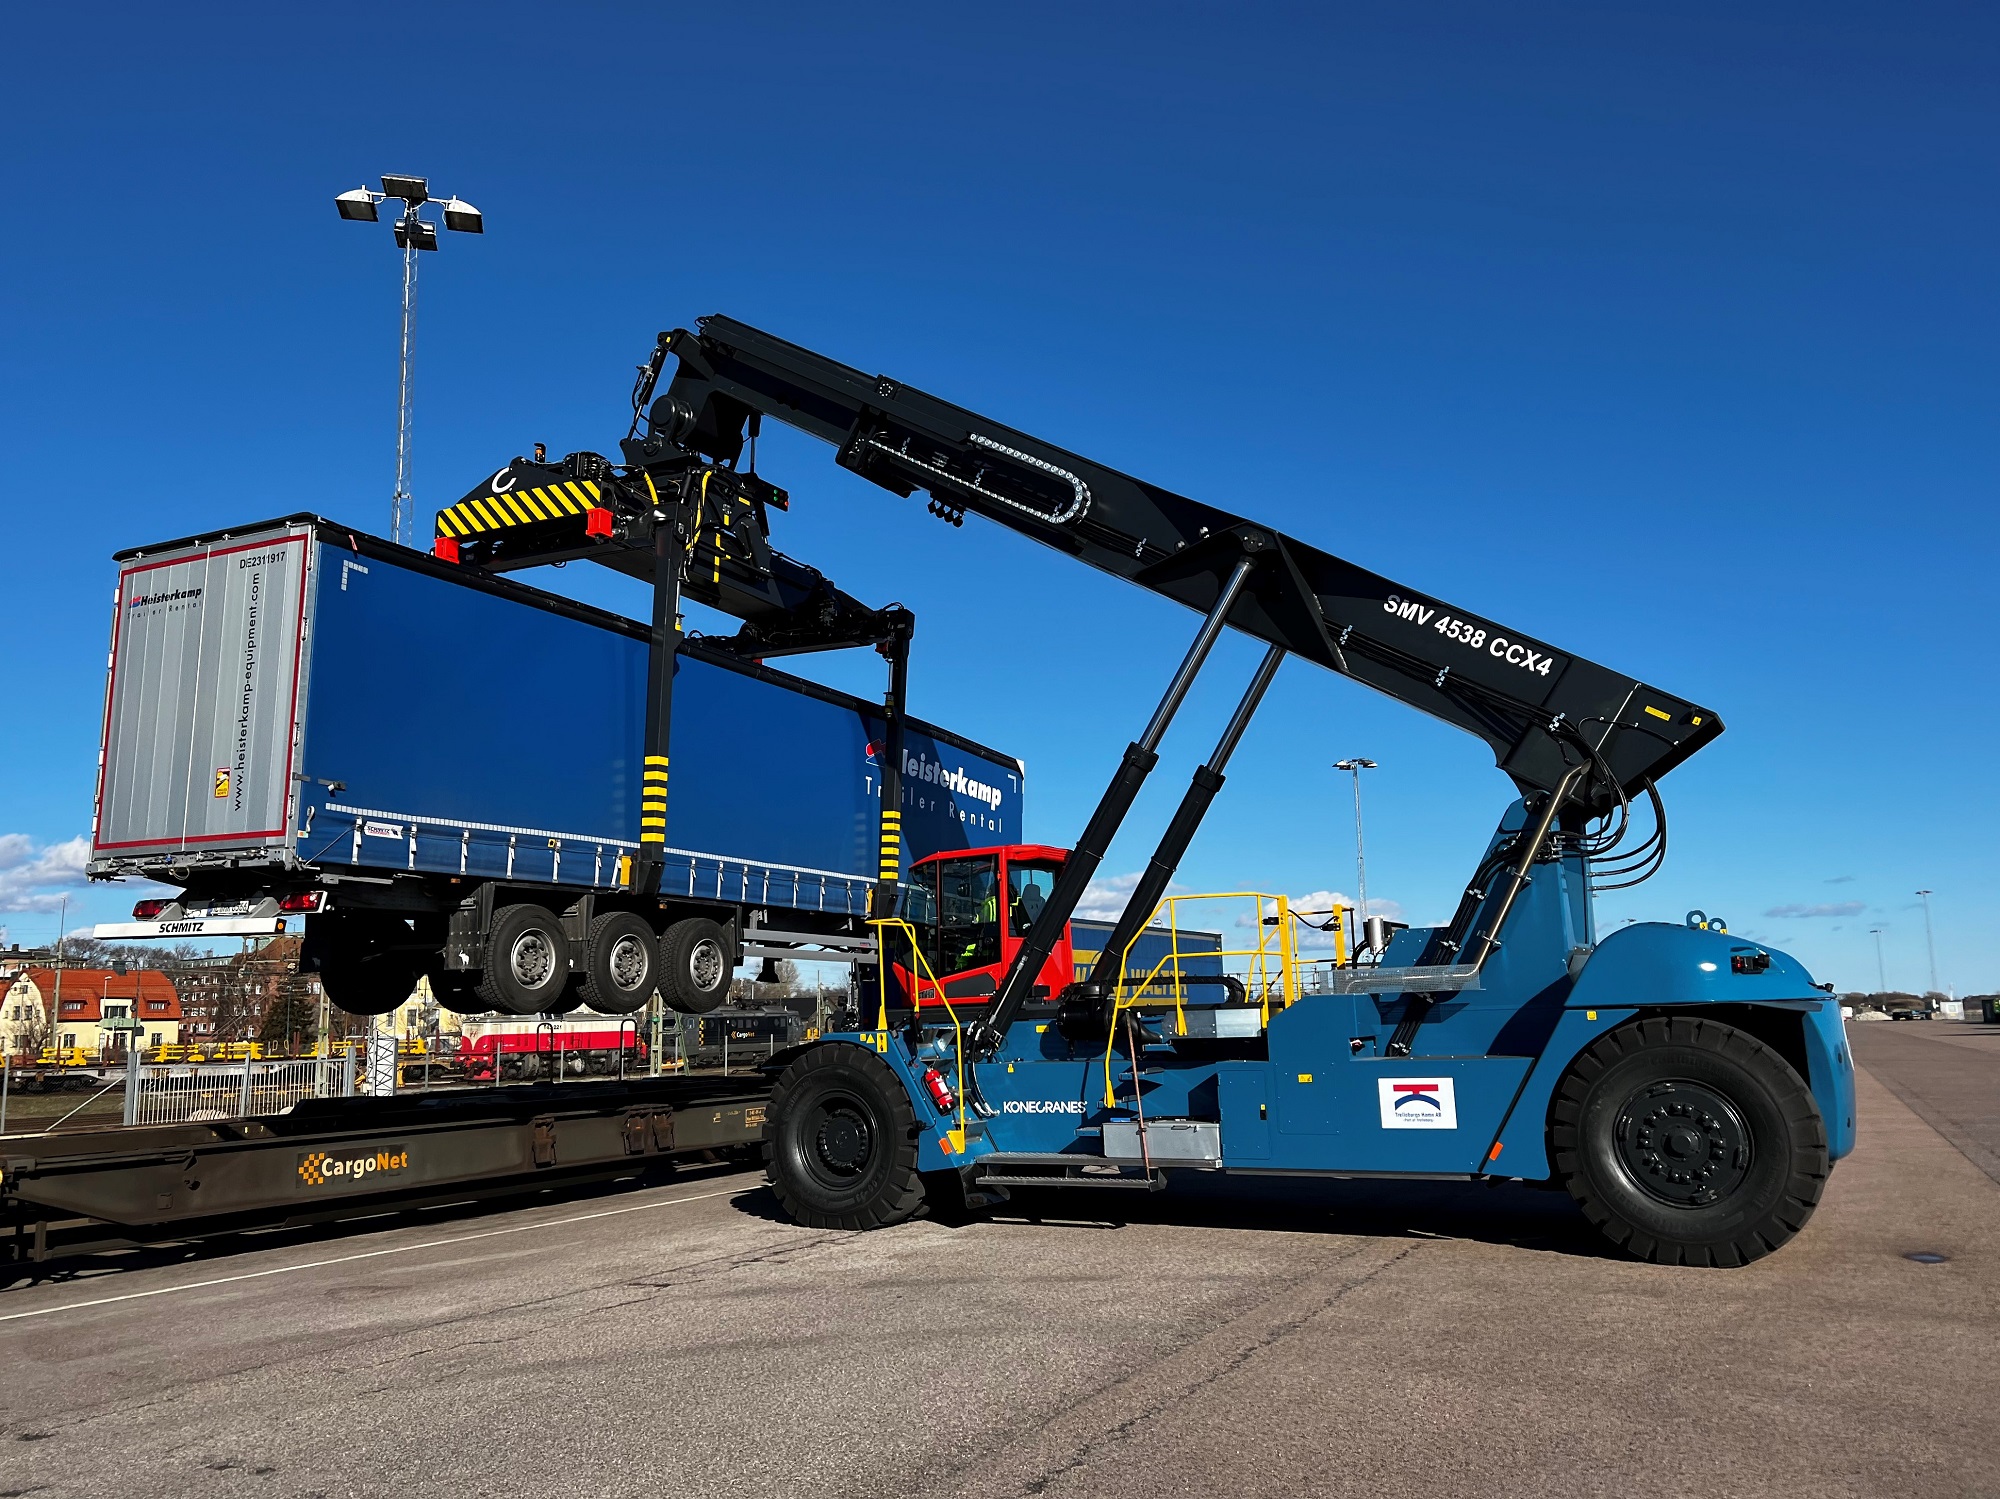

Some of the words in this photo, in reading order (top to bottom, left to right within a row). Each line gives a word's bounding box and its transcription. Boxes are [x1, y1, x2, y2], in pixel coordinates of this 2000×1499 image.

[239, 551, 286, 570] DE2311917
[140, 587, 202, 607] Heisterkamp
[168, 602, 202, 613] Rental
[1383, 594, 1435, 626] SMV
[1434, 615, 1487, 649] 4538
[1489, 637, 1554, 676] CCX4
[234, 572, 260, 812] www.heisterkamp-equipment.com
[865, 776, 936, 812] Triler
[949, 800, 1003, 834] Rental
[158, 922, 205, 934] SCHMITZ
[1003, 1100, 1088, 1114] KONECRANES
[321, 1151, 408, 1179] CargoNet
